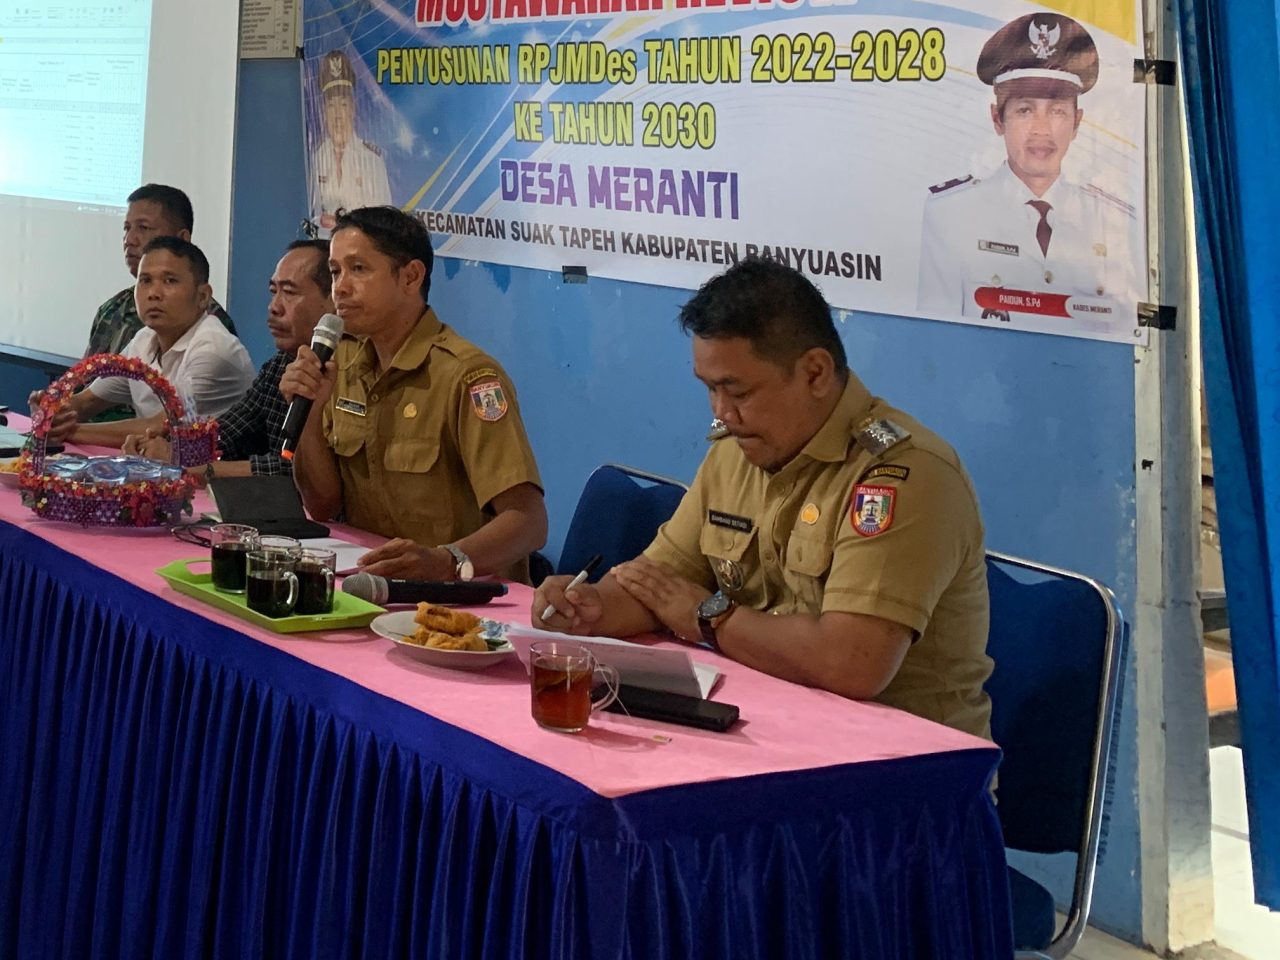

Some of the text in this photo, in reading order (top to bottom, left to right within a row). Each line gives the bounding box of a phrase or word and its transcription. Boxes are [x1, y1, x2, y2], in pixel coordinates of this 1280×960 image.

[376, 27, 946, 86] PENYUSUNAN RPJMDes TAHUN 2022-2028
[513, 101, 717, 149] KE TAHUN 2030
[500, 160, 740, 220] DESA MERANTI
[416, 210, 506, 240] KECAMATAN
[510, 219, 556, 246] SUAK
[558, 224, 617, 254] TAPEH
[620, 231, 741, 265] KABUPATEN
[1025, 297, 1041, 308] S.Pd
